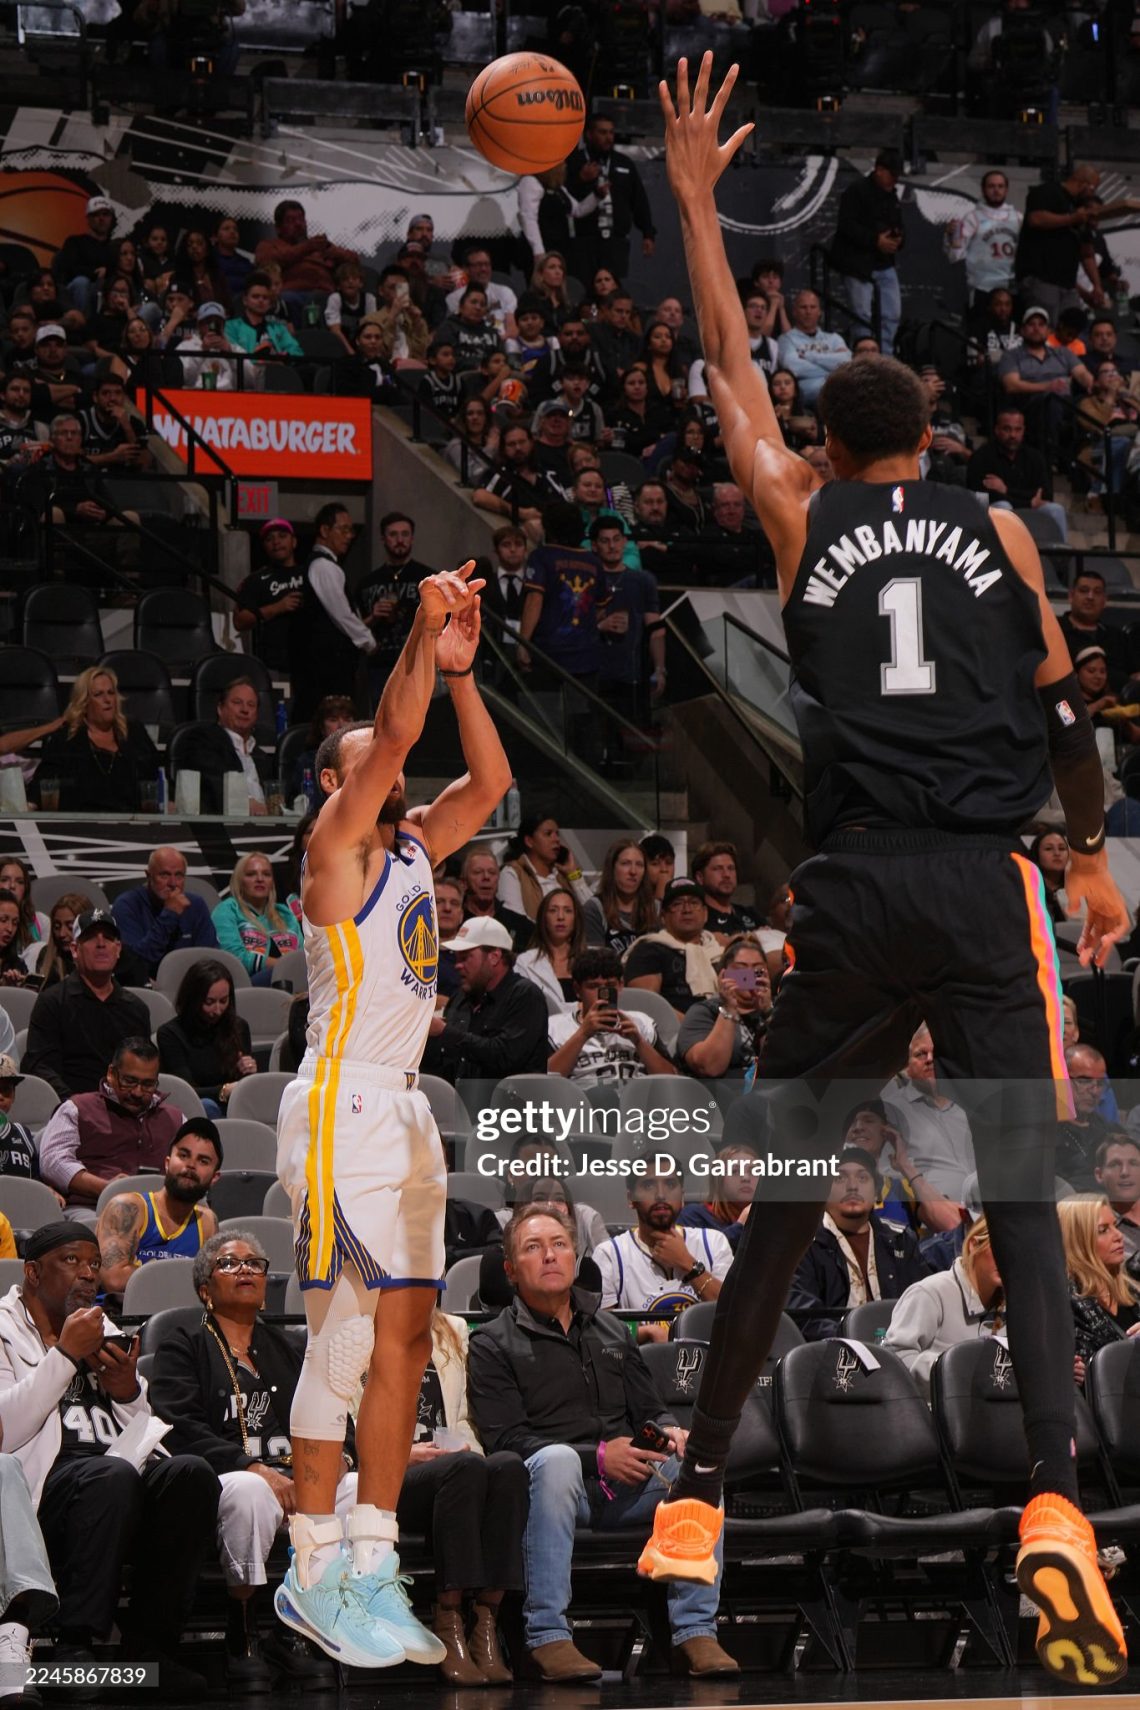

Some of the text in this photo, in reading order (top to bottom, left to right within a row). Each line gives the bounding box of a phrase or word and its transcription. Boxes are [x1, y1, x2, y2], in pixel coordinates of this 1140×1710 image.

[515, 89, 584, 112] Wilson
[991, 242, 1014, 259] 10
[152, 414, 357, 455] WHATABURGER
[238, 485, 271, 514] EXIT
[803, 519, 1003, 608] WEMBANYAMA
[878, 577, 936, 696] 1
[396, 880, 422, 912] GOLD
[63, 1405, 118, 1445] 40
